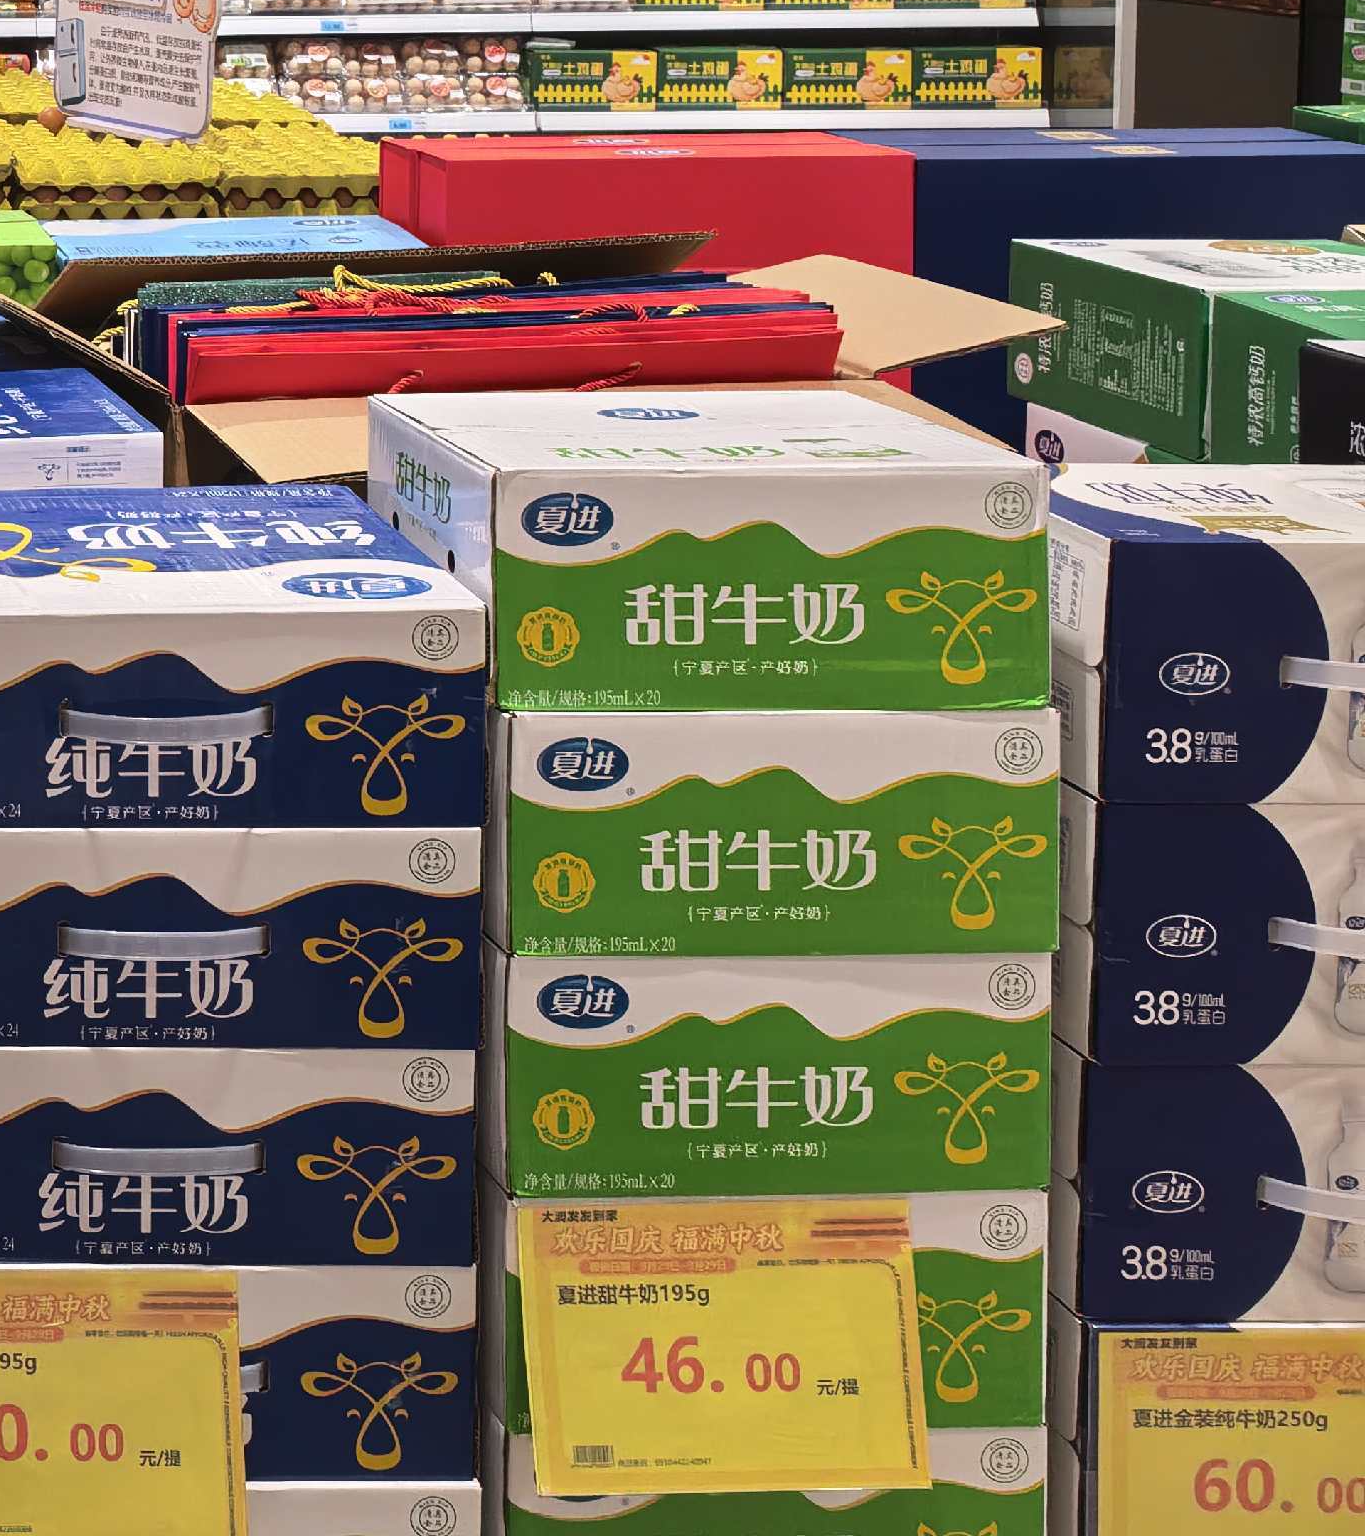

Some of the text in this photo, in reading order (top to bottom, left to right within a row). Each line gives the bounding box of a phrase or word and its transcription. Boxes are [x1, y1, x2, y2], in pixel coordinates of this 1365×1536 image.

[395, 449, 453, 525] 甜牛奶
[535, 494, 601, 538] 夏进
[69, 519, 377, 552] 纯牛奶
[624, 583, 866, 647] 甜牛奶
[1172, 661, 1218, 686] 夏进
[551, 739, 615, 783] 夏进
[1145, 727, 1192, 764] 3.8
[1194, 748, 1239, 763] 乳蛋白
[44, 737, 259, 800] 纯牛奶
[638, 828, 877, 893] 甜牛奶
[1157, 923, 1206, 948] 夏进
[42, 957, 256, 1022] 纯牛奶
[551, 976, 615, 1018] 夏进
[1132, 990, 1180, 1026] 3.8
[1181, 1009, 1226, 1026] 乳蛋白
[638, 1066, 875, 1132] 甜牛奶
[37, 1170, 250, 1235] 纯牛奶
[1144, 1180, 1192, 1203] 夏进
[552, 1223, 784, 1255] 欢乐国庆 福满中秋
[1120, 1245, 1168, 1281] 3.8
[1169, 1265, 1215, 1281] 乳蛋白
[1, 1293, 112, 1324] 福满中秋
[556, 1283, 711, 1308] 夏进甜牛奶195g
[1131, 1353, 1243, 1384] 欢乐国庆
[1132, 1408, 1329, 1432] 夏进金装纯牛奶250g
